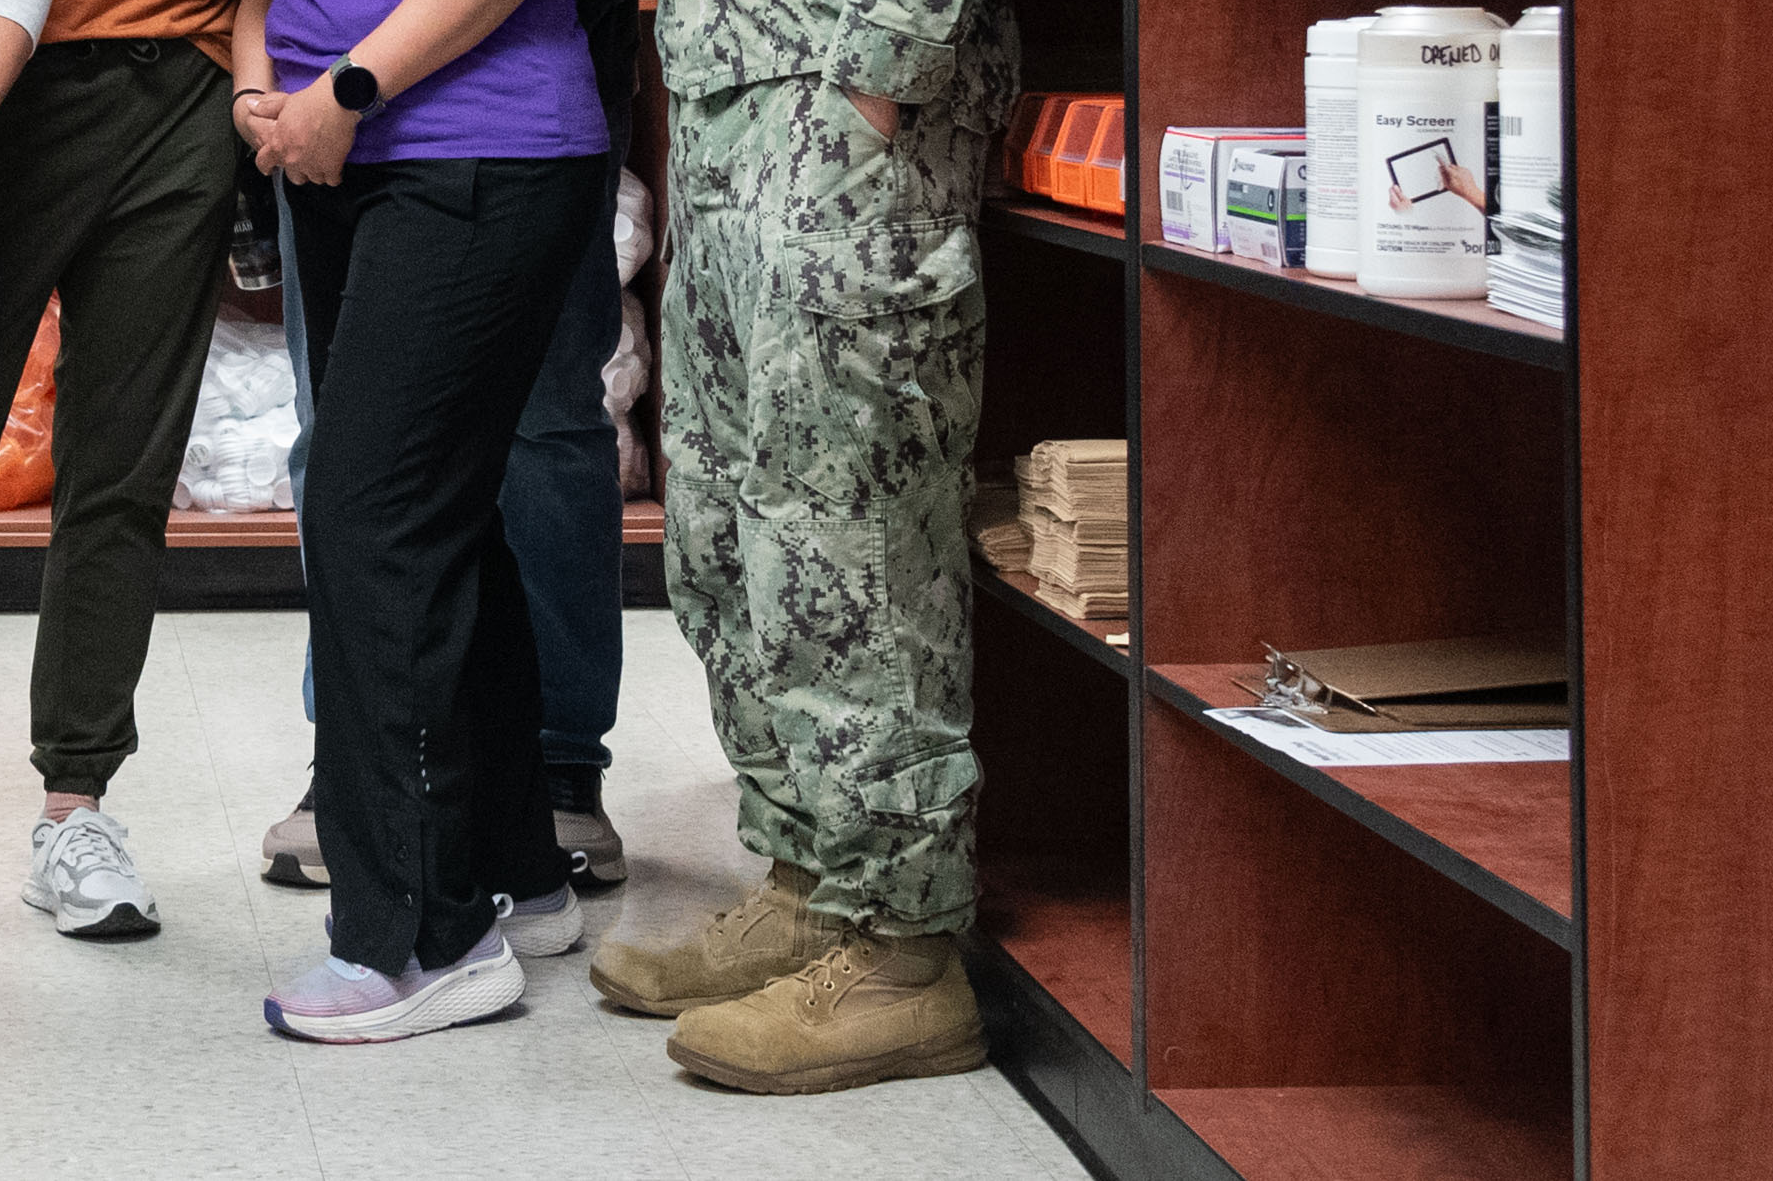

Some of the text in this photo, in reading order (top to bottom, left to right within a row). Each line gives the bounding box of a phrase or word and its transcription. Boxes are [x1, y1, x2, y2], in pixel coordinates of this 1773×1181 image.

[1421, 43, 1482, 67] OPENED
[1376, 114, 1456, 128] Easy Screen
